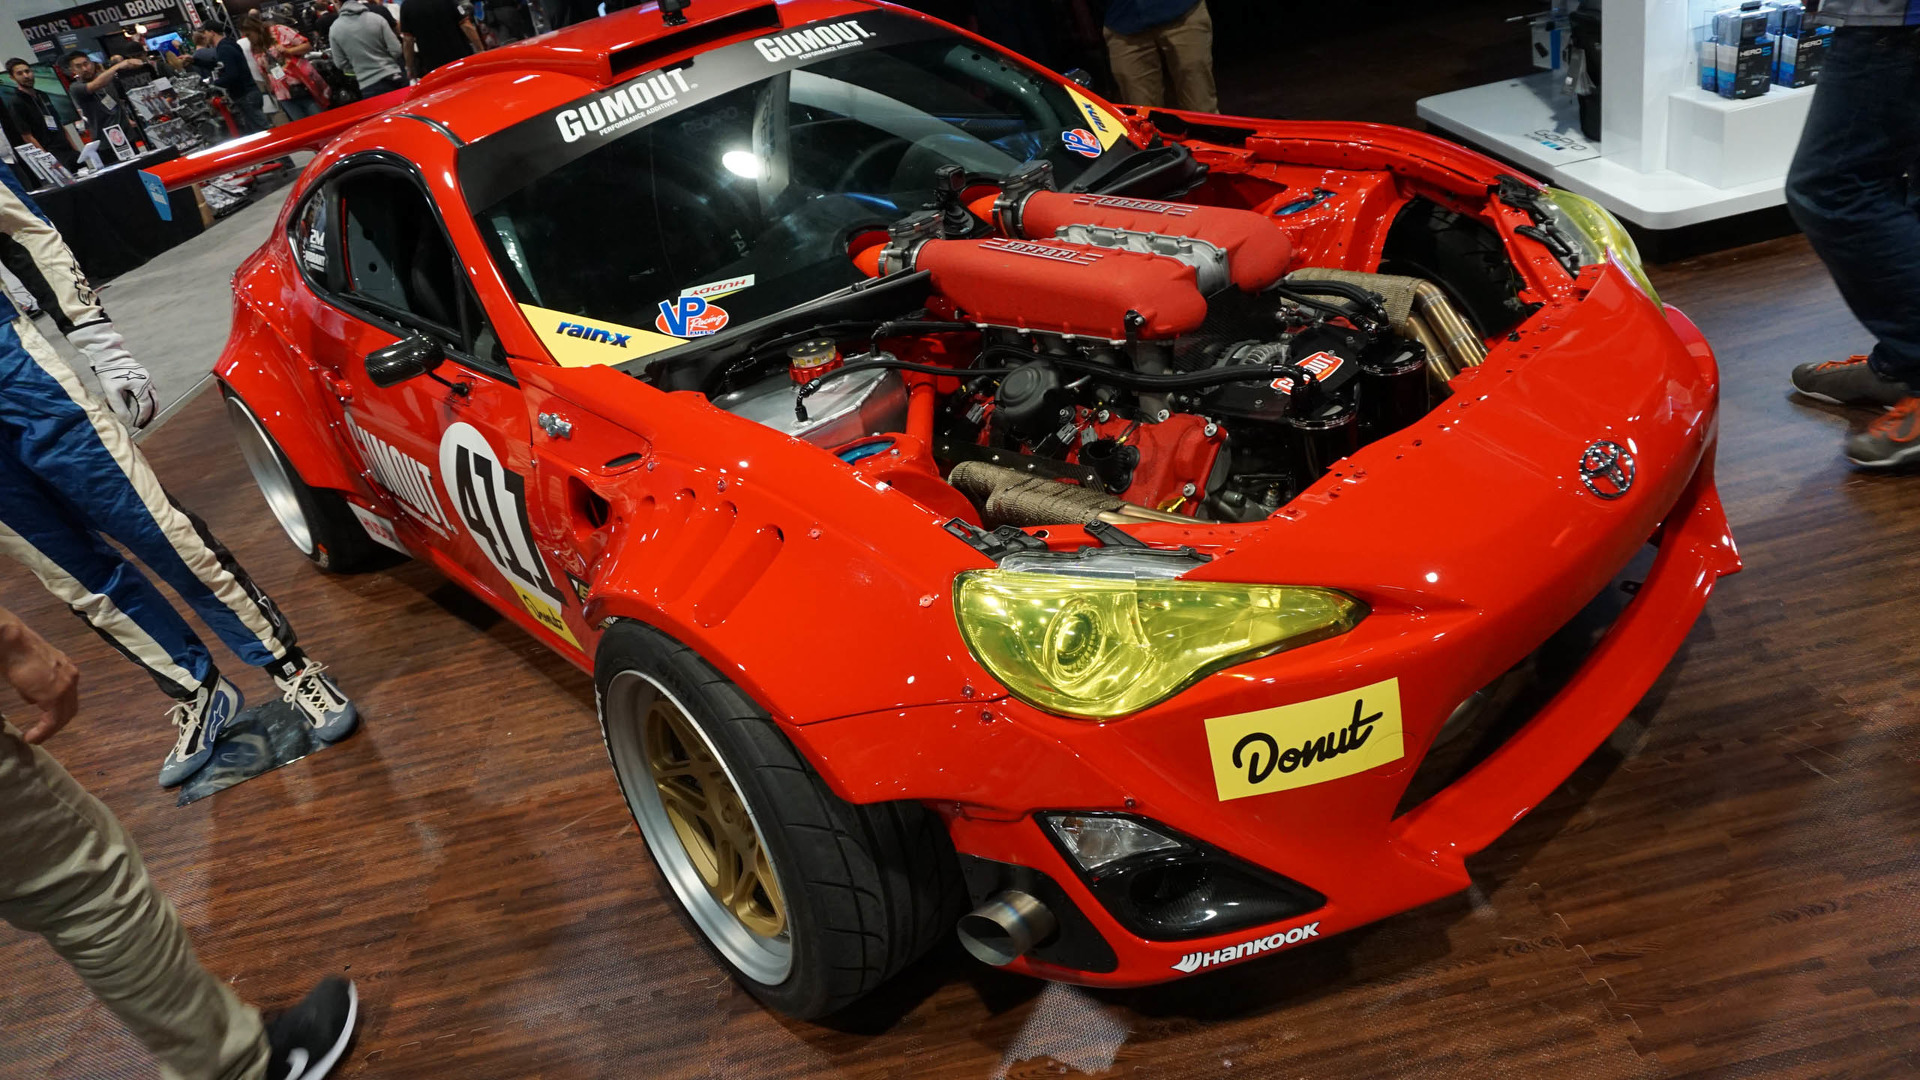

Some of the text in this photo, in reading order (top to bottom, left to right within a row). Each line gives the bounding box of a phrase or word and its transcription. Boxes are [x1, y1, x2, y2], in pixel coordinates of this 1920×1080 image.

[88, 8, 127, 26] TOOL
[125, 0, 176, 17] BRAND
[754, 20, 870, 62] GUMOUT
[798, 46, 838, 60] PERFORMANCE
[555, 67, 690, 143] GUMOUT
[599, 98, 679, 136] PERFORMANCE ADDITIVES
[1534, 130, 1587, 150] GoPro
[691, 279, 746, 296] HUDDY
[659, 297, 707, 336] VP
[689, 313, 728, 331] Racing
[344, 411, 453, 532] GUMOUT
[456, 443, 570, 608] 411
[1232, 699, 1384, 784] Donut
